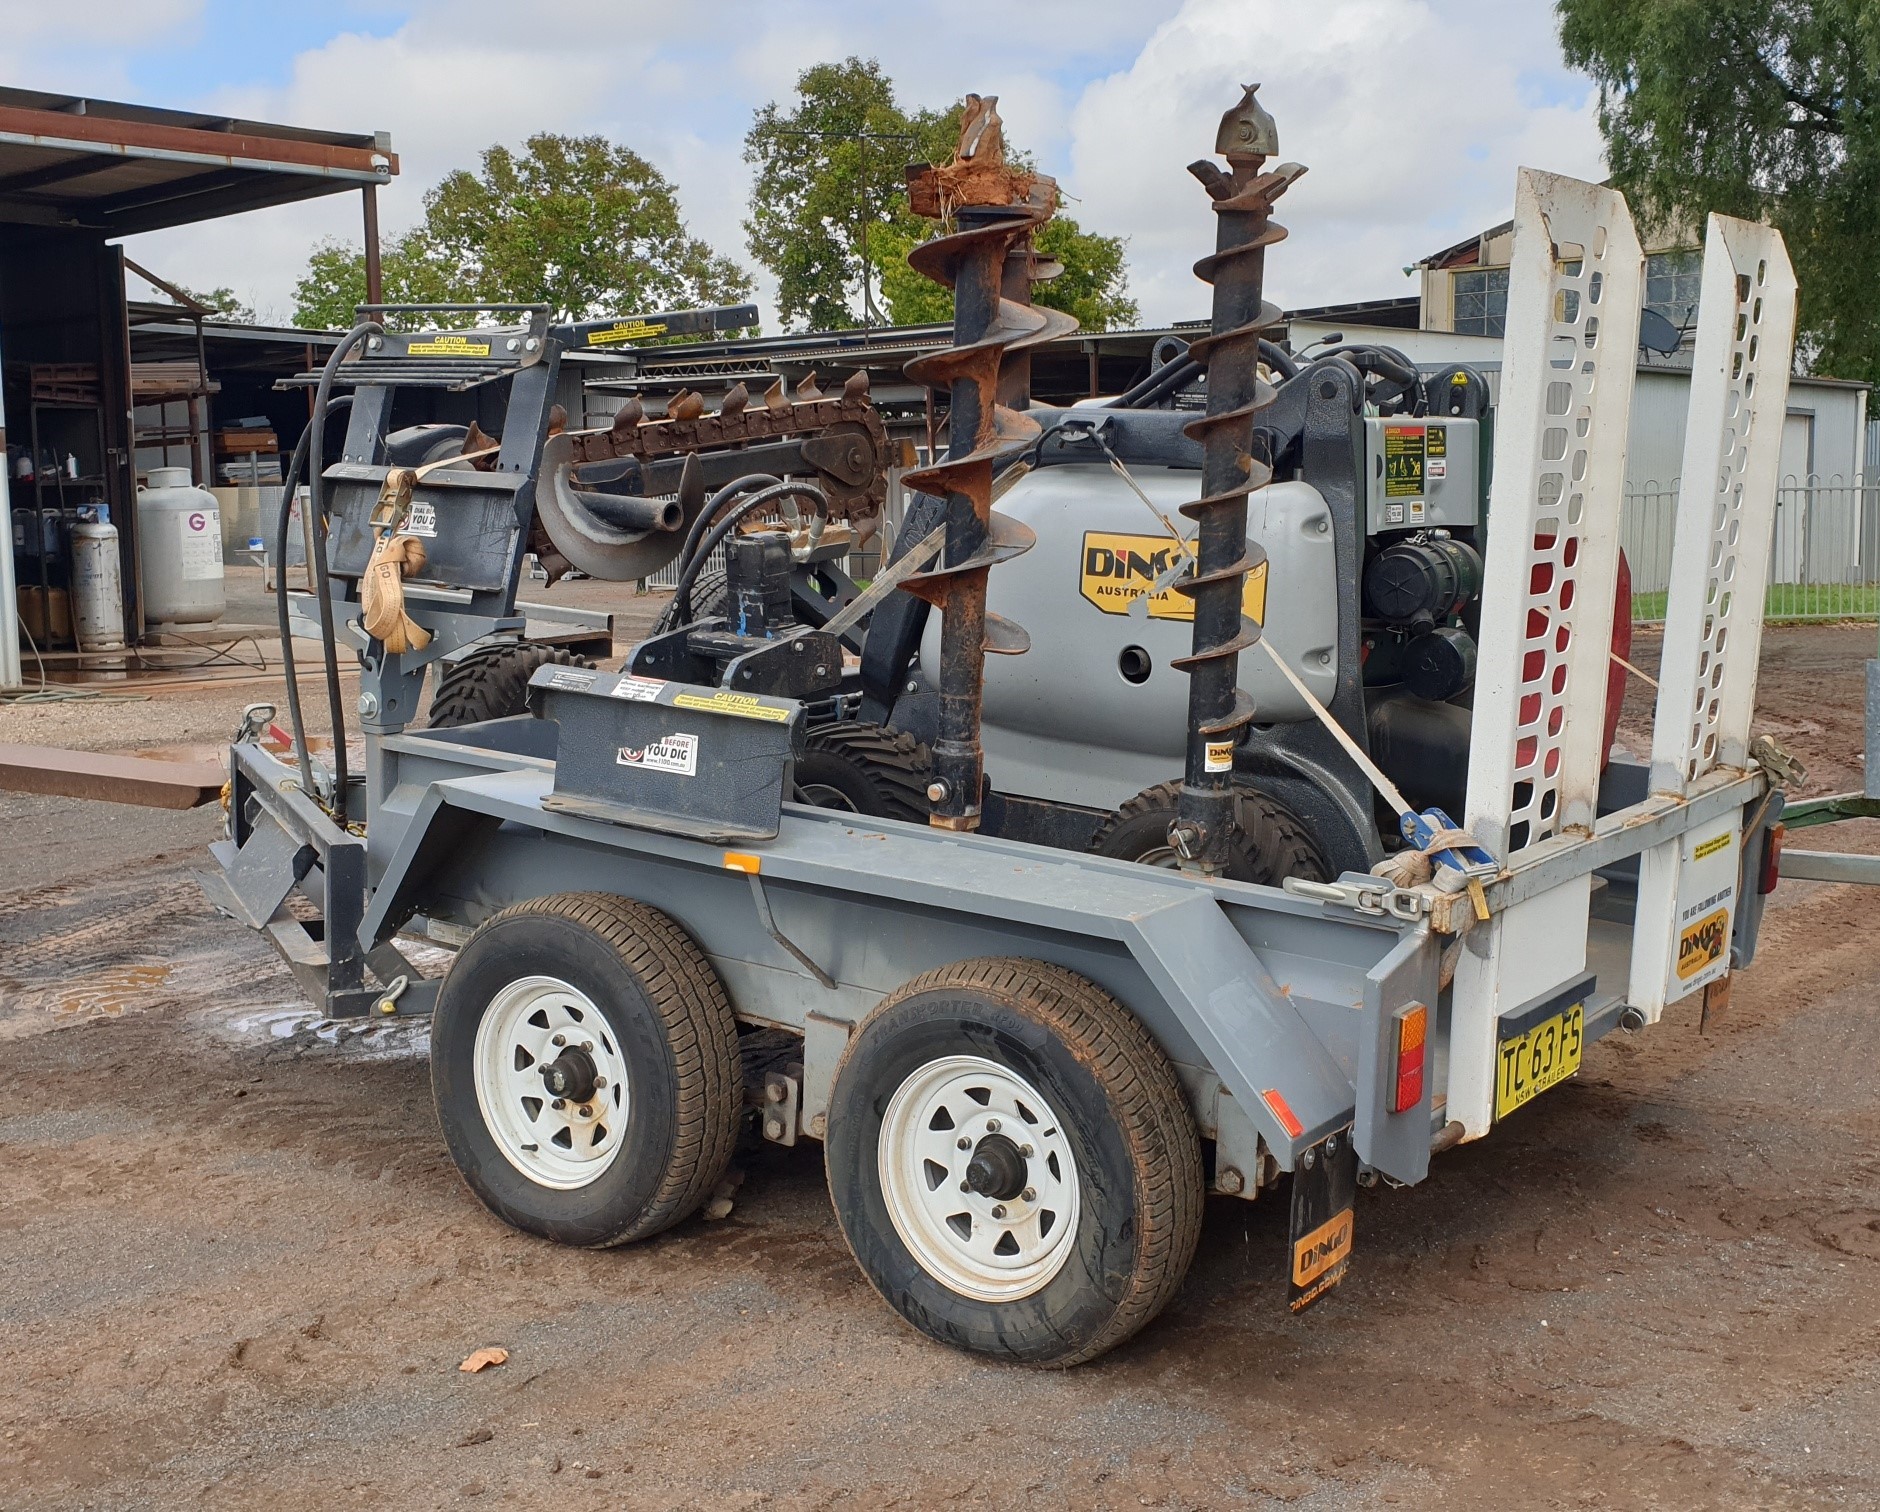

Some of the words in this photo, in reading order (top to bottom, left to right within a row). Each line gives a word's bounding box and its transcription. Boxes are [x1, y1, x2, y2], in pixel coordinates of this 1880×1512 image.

[613, 319, 646, 330] CAUTION
[434, 336, 467, 344] CAUTION
[412, 514, 428, 524] YOU
[714, 692, 760, 706] CAUTION
[664, 738, 690, 749] BEFORE
[647, 745, 669, 758] YOU
[669, 748, 688, 760] DIG
[1682, 908, 1690, 922] YOU
[1690, 904, 1698, 918] ARE
[1515, 1085, 1532, 1104] NSW
[1537, 1065, 1566, 1089] TRAILER
[1299, 1222, 1349, 1274] DINGO
